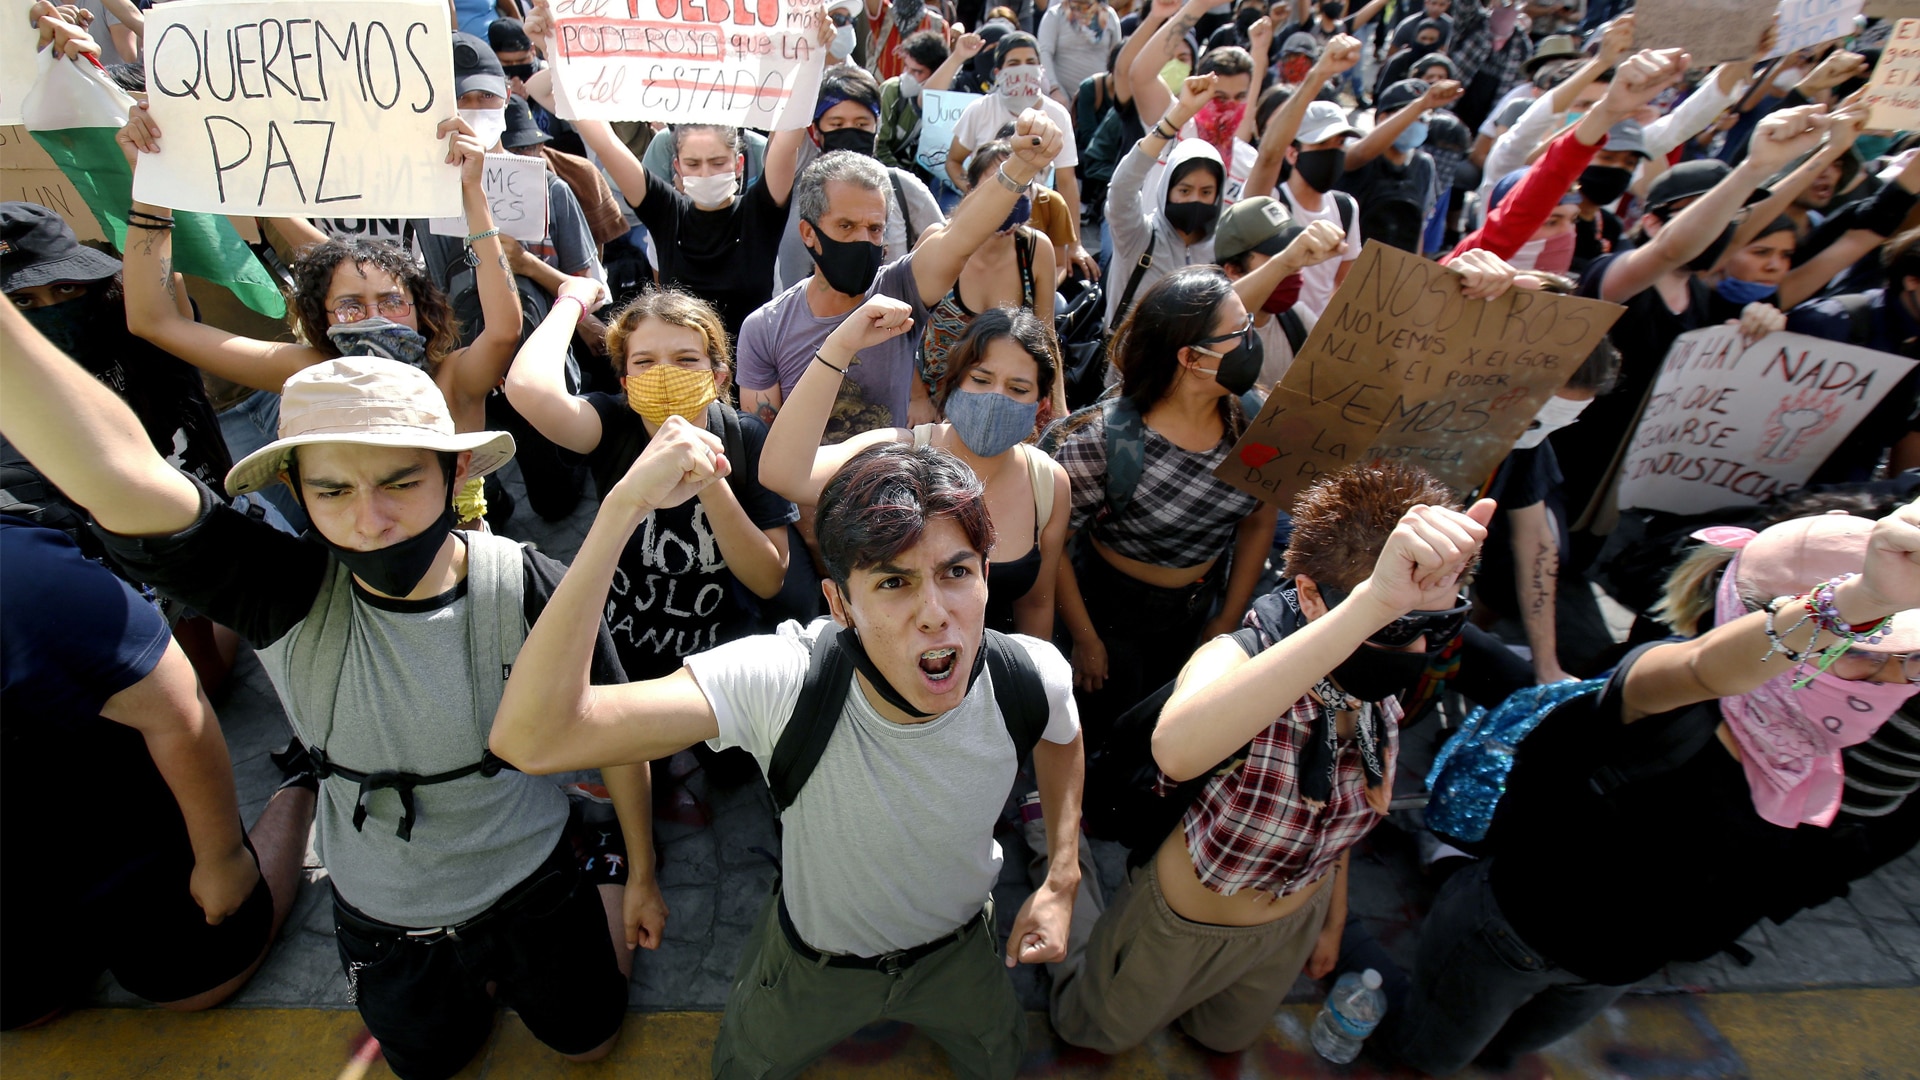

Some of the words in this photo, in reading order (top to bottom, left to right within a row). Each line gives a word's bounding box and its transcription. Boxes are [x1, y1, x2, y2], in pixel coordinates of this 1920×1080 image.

[153, 18, 434, 113] QUEREMOS
[562, 25, 720, 64] PODEROSA
[731, 33, 772, 62] que
[782, 35, 815, 60] LA
[577, 66, 626, 104] del
[204, 115, 362, 207] PAZ
[1320, 333, 1357, 364] NI
[1445, 370, 1511, 388] PODER
[1335, 303, 1371, 334] NO
[1376, 320, 1446, 355] VEMOS
[1515, 349, 1560, 370] GOB
[1310, 361, 1490, 434] VEMOS
[1682, 385, 1738, 414] QUE
[1761, 346, 1877, 400] NADA
